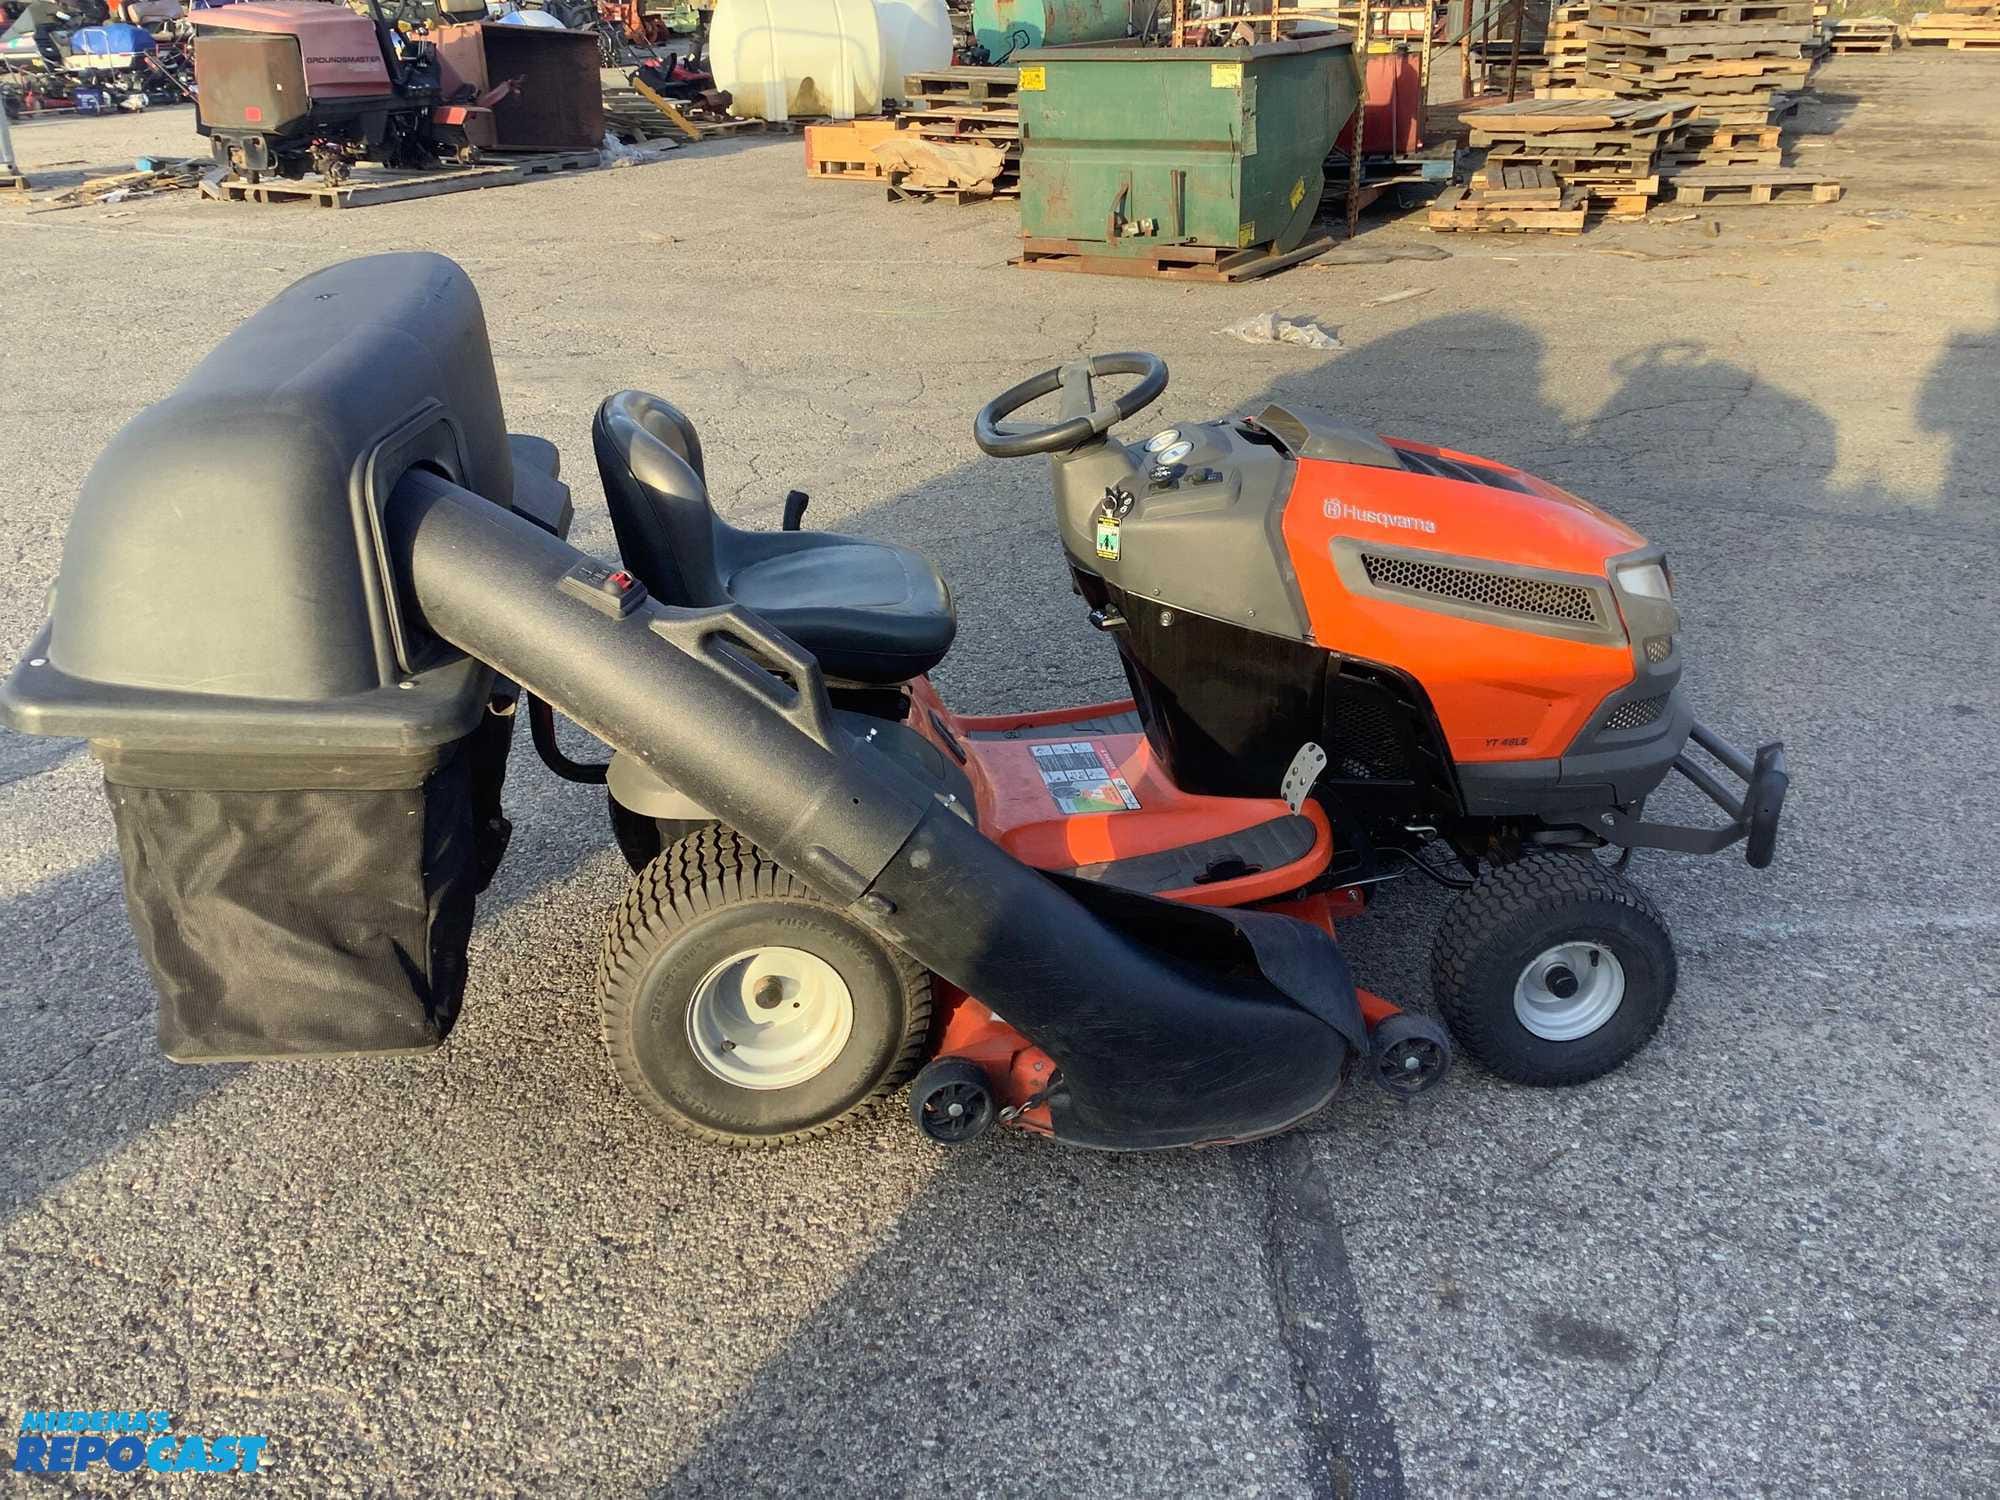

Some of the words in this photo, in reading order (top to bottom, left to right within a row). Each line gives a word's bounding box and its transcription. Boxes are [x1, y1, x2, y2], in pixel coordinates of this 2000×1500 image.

[306, 56, 382, 64] GROUNDSMASTER
[1343, 503, 1437, 533] Husqvarna
[1486, 738, 1499, 746] YT
